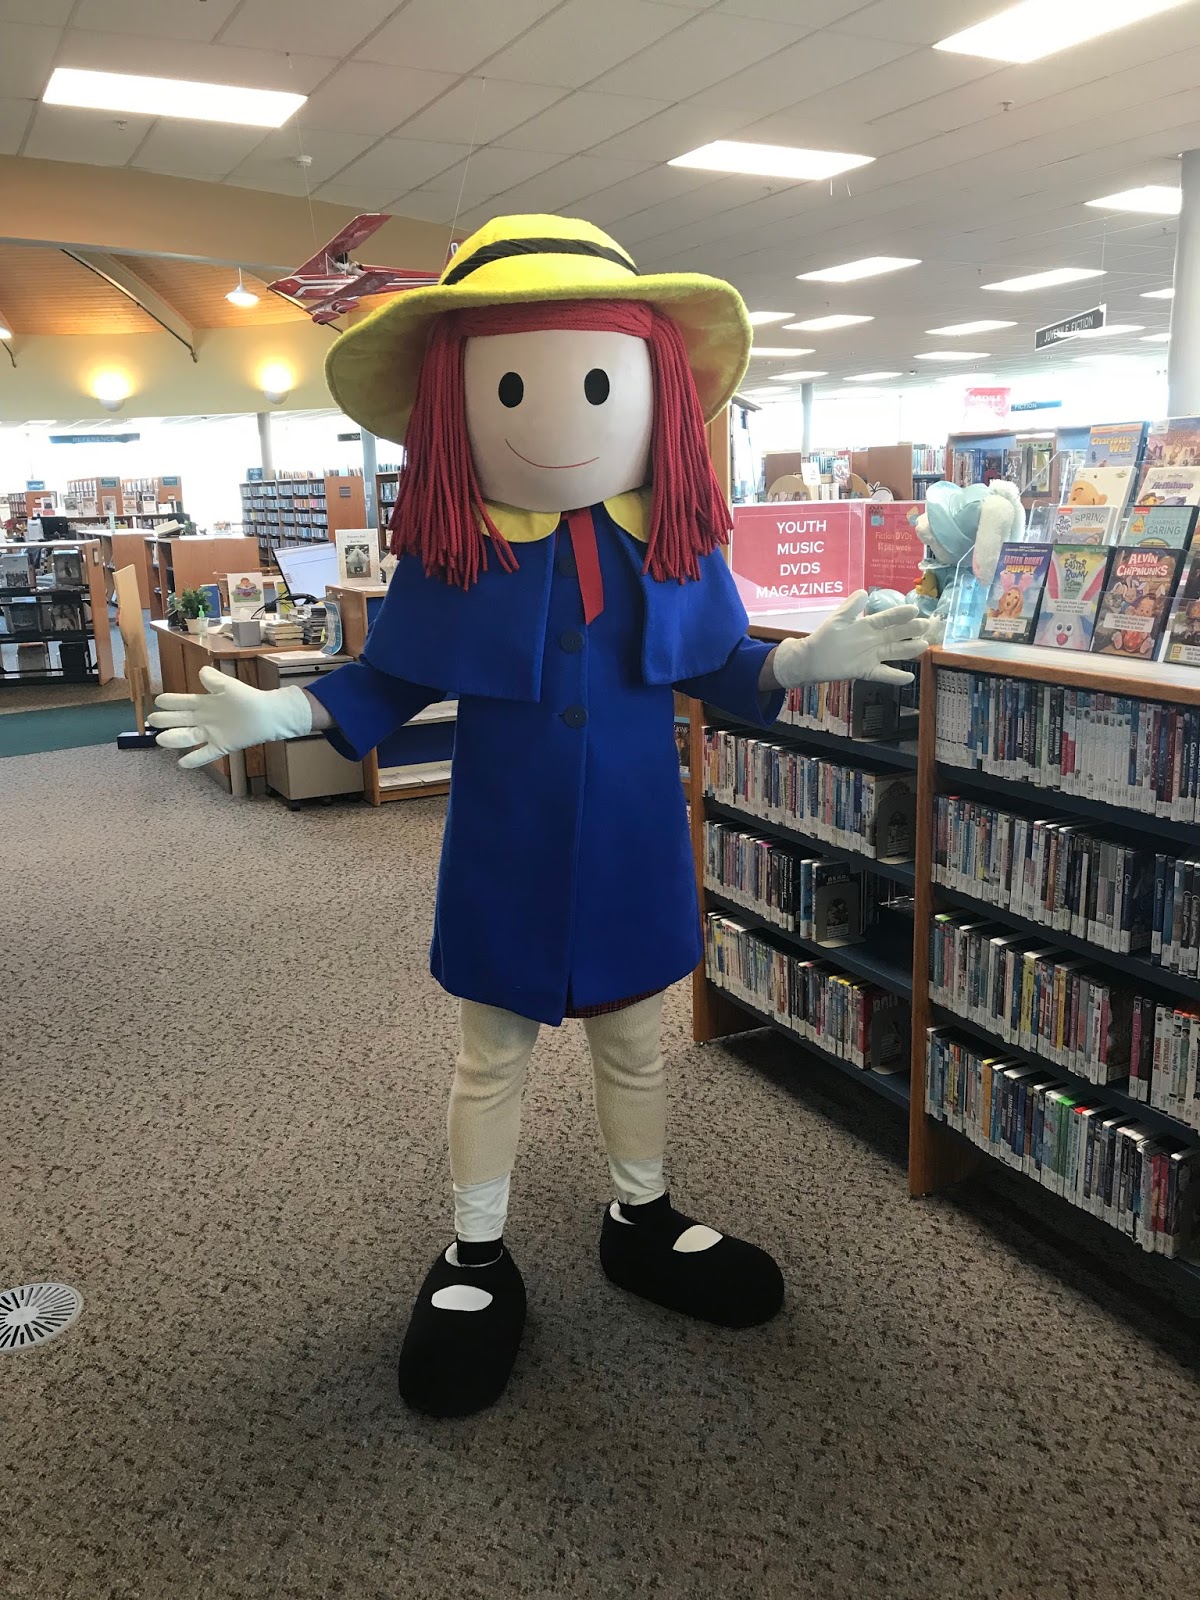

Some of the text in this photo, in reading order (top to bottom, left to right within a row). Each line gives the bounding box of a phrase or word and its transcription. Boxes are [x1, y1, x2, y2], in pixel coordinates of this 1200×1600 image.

[1071, 315, 1094, 332] FICTION
[1014, 402, 1037, 410] FICTION
[1075, 512, 1105, 524] SPRING
[776, 520, 827, 535] YOUTH
[1147, 525, 1181, 536] CARING
[875, 531, 913, 541] Fiction DVDs
[777, 541, 825, 555] MUSIC
[1064, 558, 1087, 570] EASTER
[1128, 552, 1159, 565] ALVIN
[780, 562, 821, 576] DVDS
[1005, 565, 1037, 575] PUPPY
[1116, 564, 1168, 577] CHIPMUNKS
[756, 581, 844, 599] MAGAZINES
